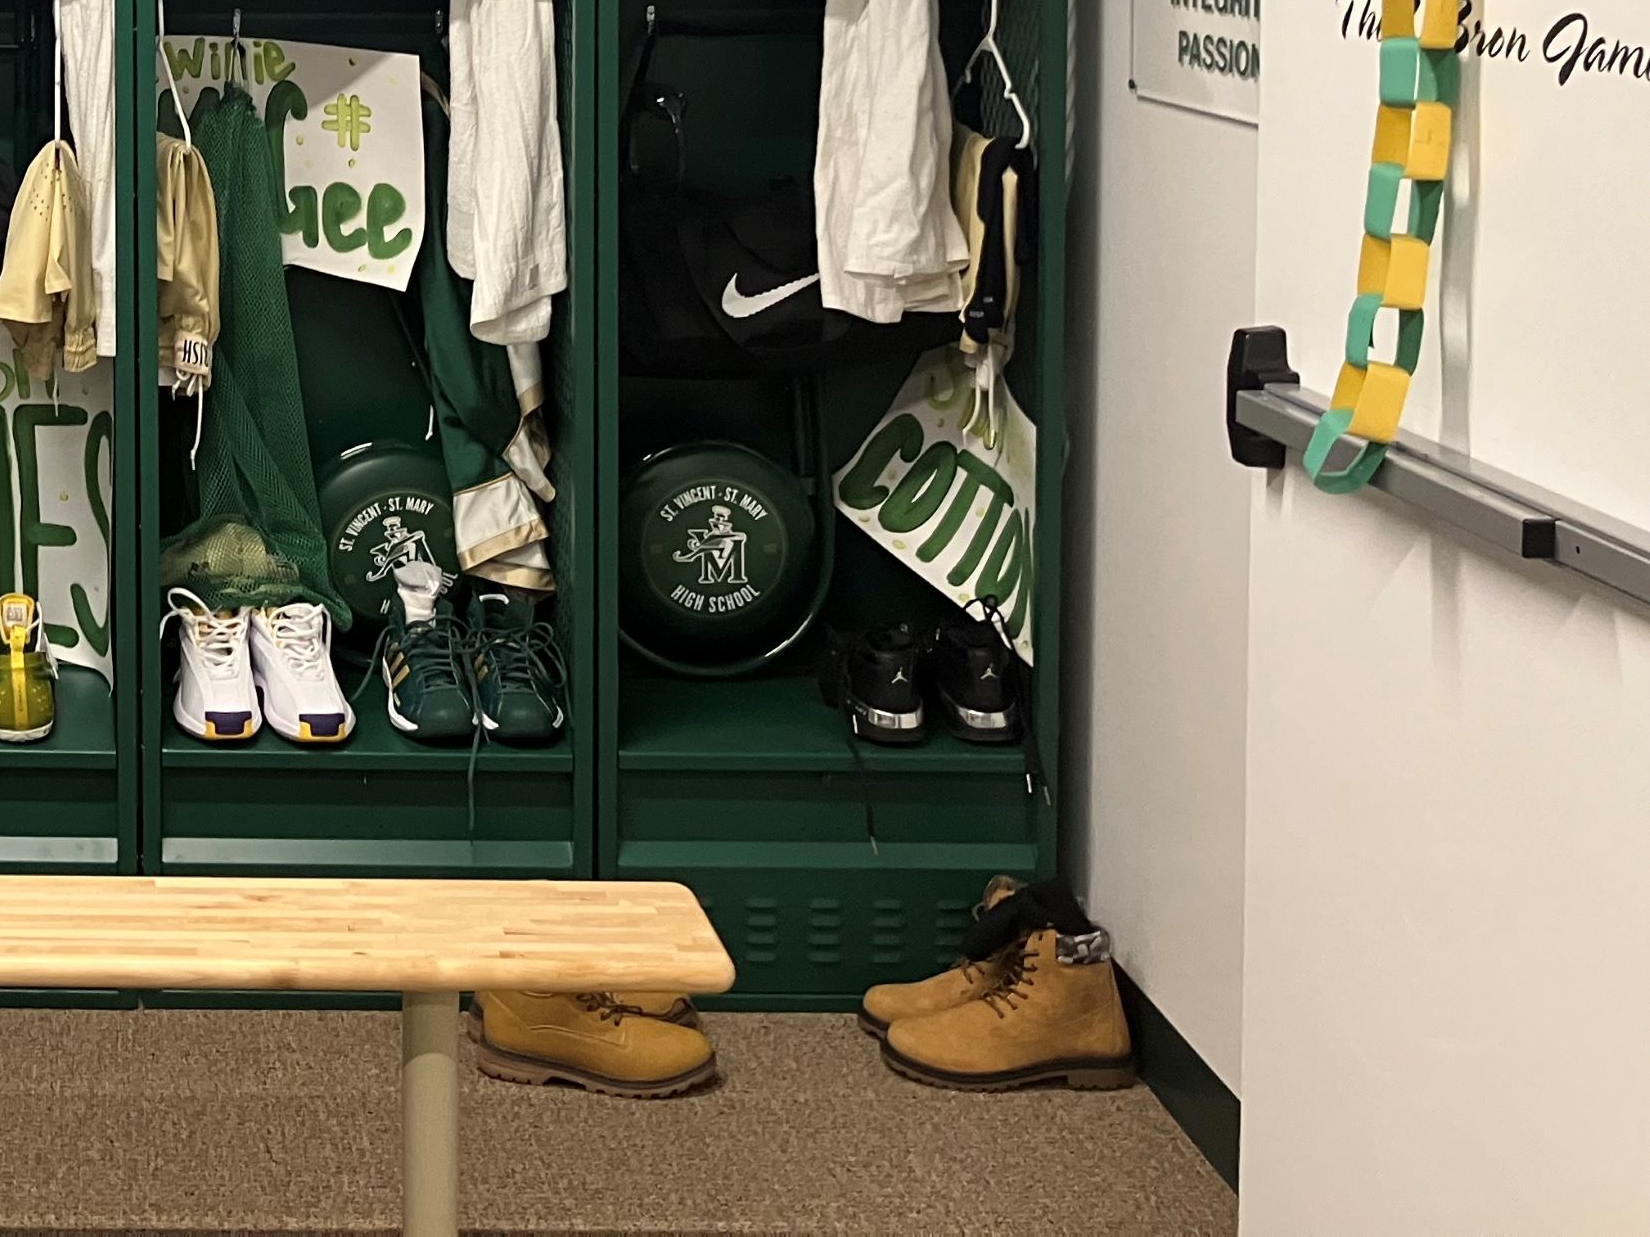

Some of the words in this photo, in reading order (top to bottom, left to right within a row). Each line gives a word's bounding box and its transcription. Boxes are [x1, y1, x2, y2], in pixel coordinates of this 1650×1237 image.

[345, 502, 382, 537] VINCENT
[387, 496, 403, 512] ST.
[405, 496, 435, 515] MARY
[672, 485, 717, 510] VINCENT
[723, 486, 739, 505] ST.
[739, 493, 768, 521] MARY
[670, 584, 705, 611] HIGH
[708, 583, 761, 613] SCHOOL
